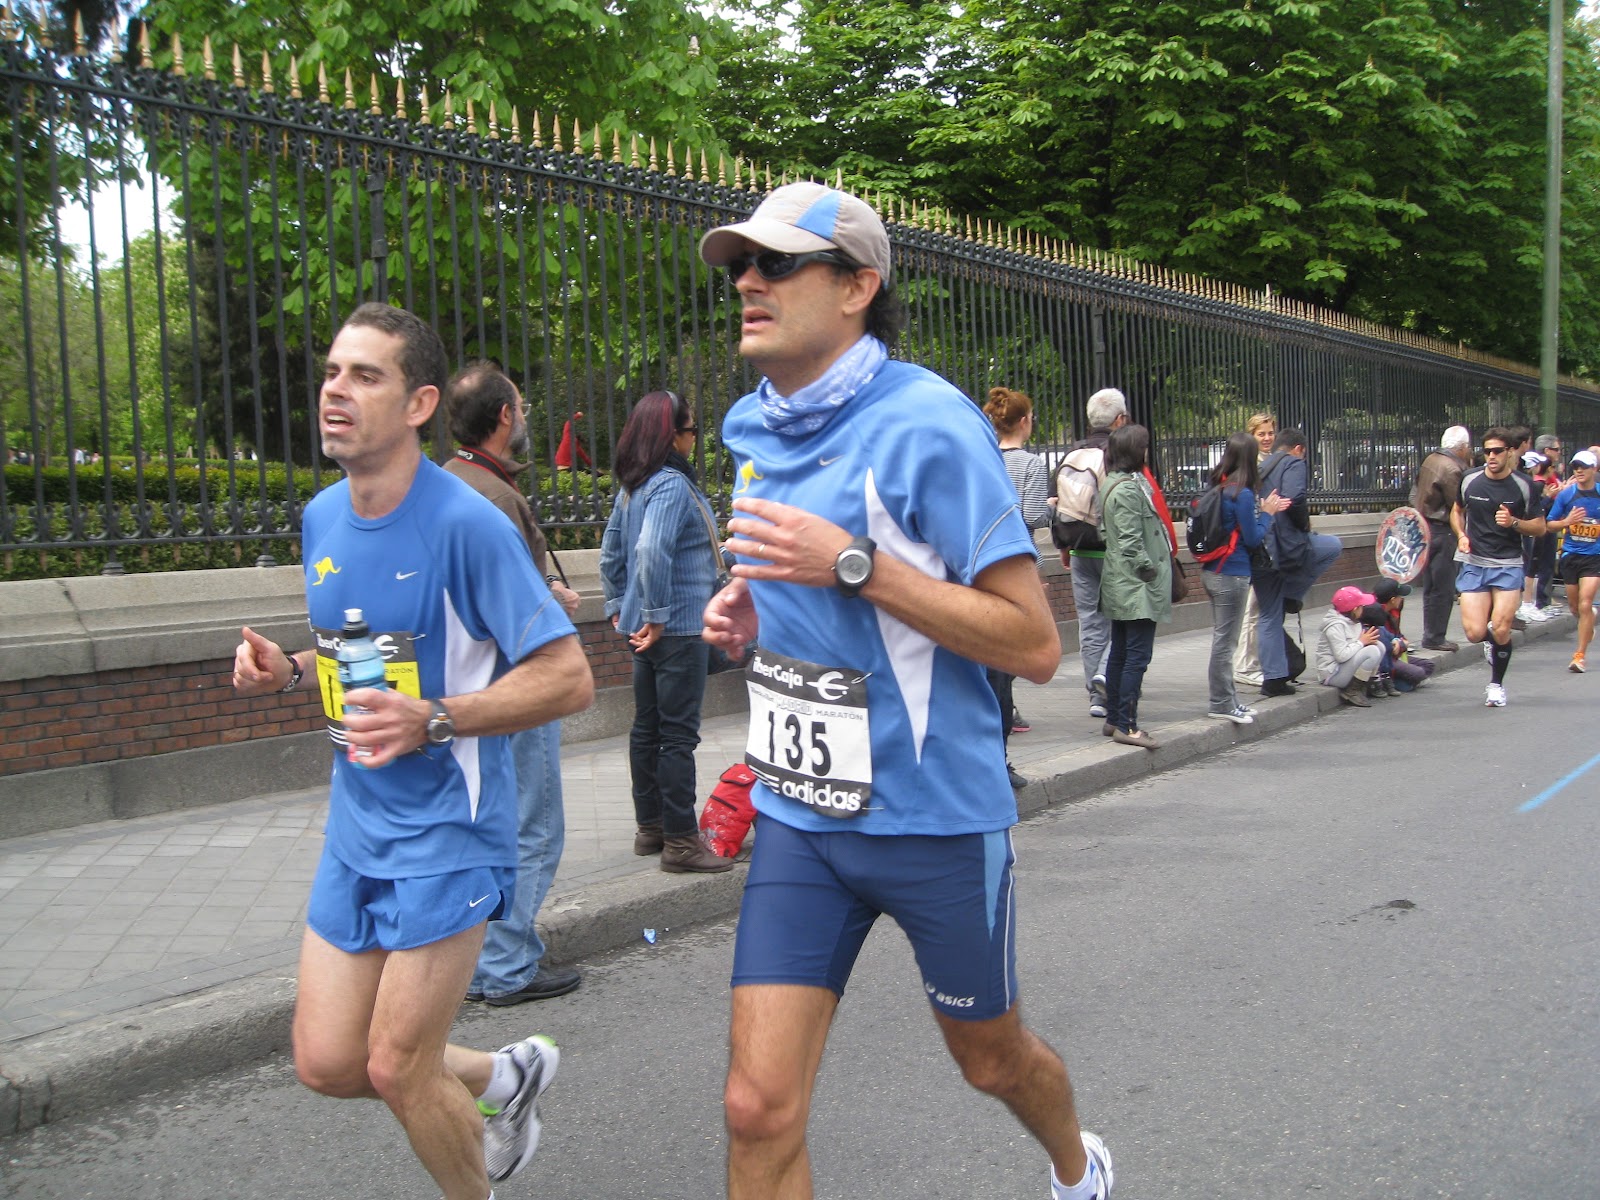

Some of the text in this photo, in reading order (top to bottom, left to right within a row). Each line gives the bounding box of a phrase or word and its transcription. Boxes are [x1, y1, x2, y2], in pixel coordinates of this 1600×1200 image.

[1571, 524, 1597, 537] 3030
[768, 710, 832, 777] 135
[781, 780, 862, 812] adidas
